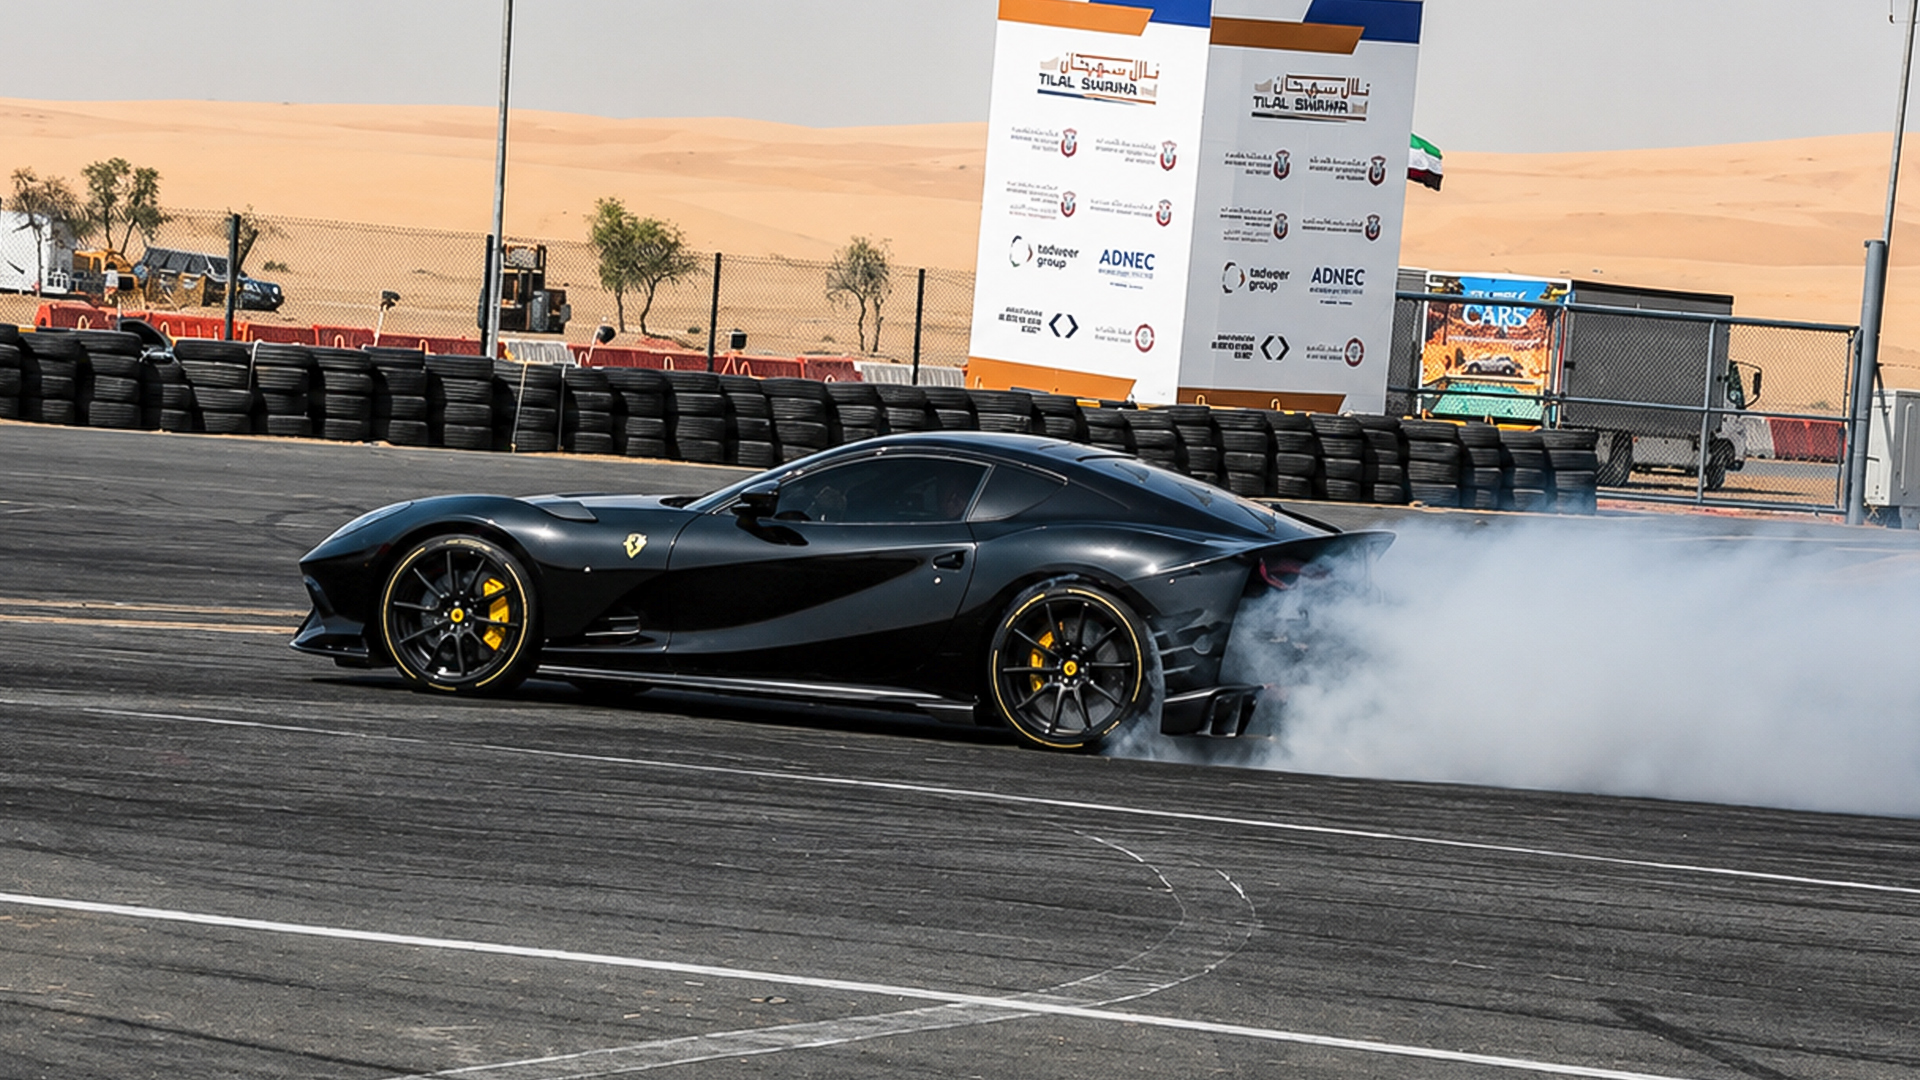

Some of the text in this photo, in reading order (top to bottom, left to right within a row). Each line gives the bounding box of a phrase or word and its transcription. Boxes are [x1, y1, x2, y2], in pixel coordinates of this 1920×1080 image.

[1039, 72, 1075, 89] TILAL
[1253, 95, 1289, 110] TILAL
[1036, 256, 1067, 270] group
[1099, 249, 1156, 271] ADNEC
[1311, 266, 1366, 286] ADNEC
[1248, 280, 1279, 293] group
[1462, 304, 1528, 328] CARS
